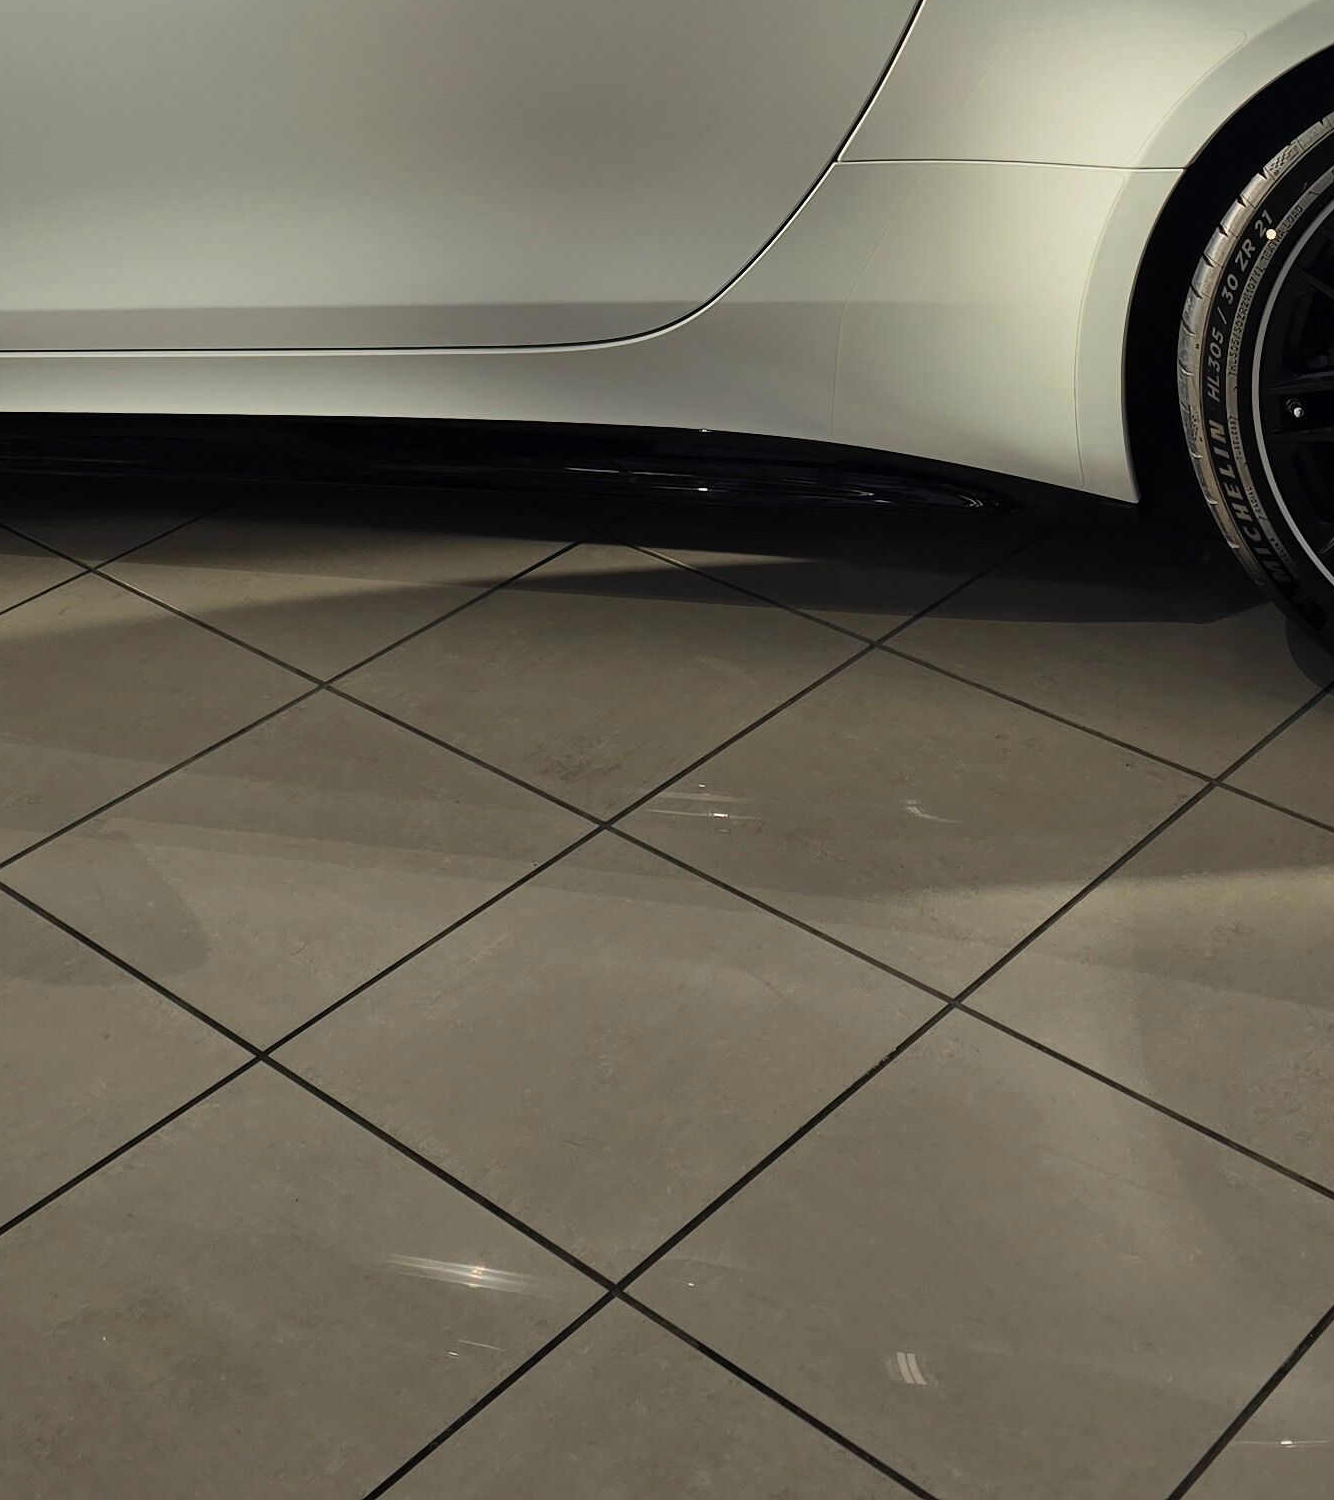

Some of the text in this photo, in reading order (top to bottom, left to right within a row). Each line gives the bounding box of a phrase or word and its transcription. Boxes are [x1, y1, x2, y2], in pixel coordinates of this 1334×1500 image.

[1255, 209, 1274, 236] 21
[1235, 238, 1257, 272] ZR
[1222, 274, 1239, 305] 30
[1207, 331, 1224, 403] HL305
[1208, 419, 1292, 584] MICHELIN
